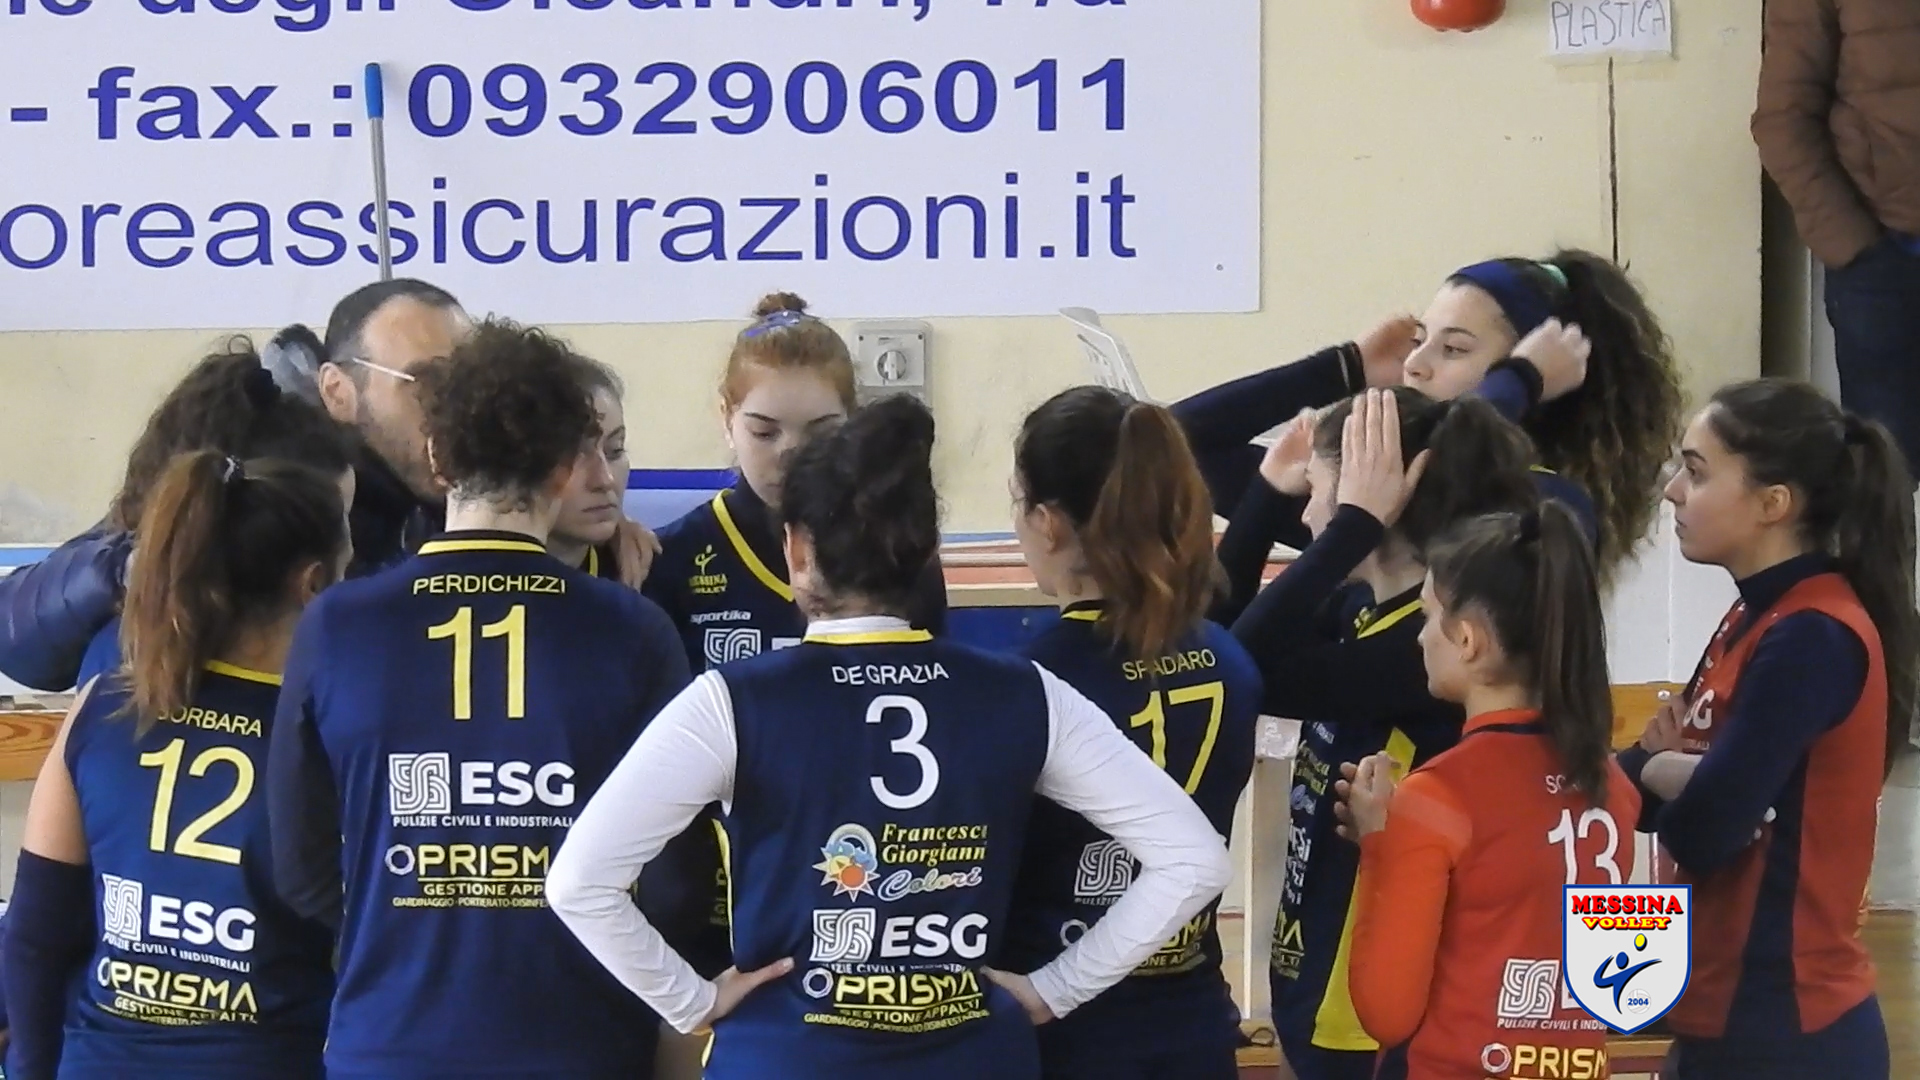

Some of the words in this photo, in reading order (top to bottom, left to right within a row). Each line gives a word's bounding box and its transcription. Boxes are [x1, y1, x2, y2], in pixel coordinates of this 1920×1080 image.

[1551, 0, 1666, 49] PLASTICA
[408, 57, 1126, 138] 0932906011
[0, 172, 1136, 268] oreassicurazioni.it
[413, 573, 566, 595] PERDICHIZZI
[690, 609, 752, 625] sportika
[428, 604, 525, 720] 11
[865, 695, 940, 810] 3
[1130, 681, 1224, 795] 17
[139, 738, 255, 865] 12
[460, 761, 576, 806] ESG
[393, 816, 437, 828] PULIZIE
[442, 815, 480, 827] CIVILI
[484, 816, 492, 827] E
[496, 816, 573, 828] INDUSTRIALI
[417, 844, 550, 877] PRISM
[1547, 808, 1622, 884] 13
[423, 883, 507, 896] GESTIONE
[510, 884, 544, 896] APP
[877, 866, 983, 901] Colori
[150, 894, 257, 953] ESG
[880, 913, 989, 959] ESG
[133, 942, 168, 955] CIVILI
[179, 949, 250, 973] INDUSTRIALI
[1513, 1044, 1608, 1079] PRISM
